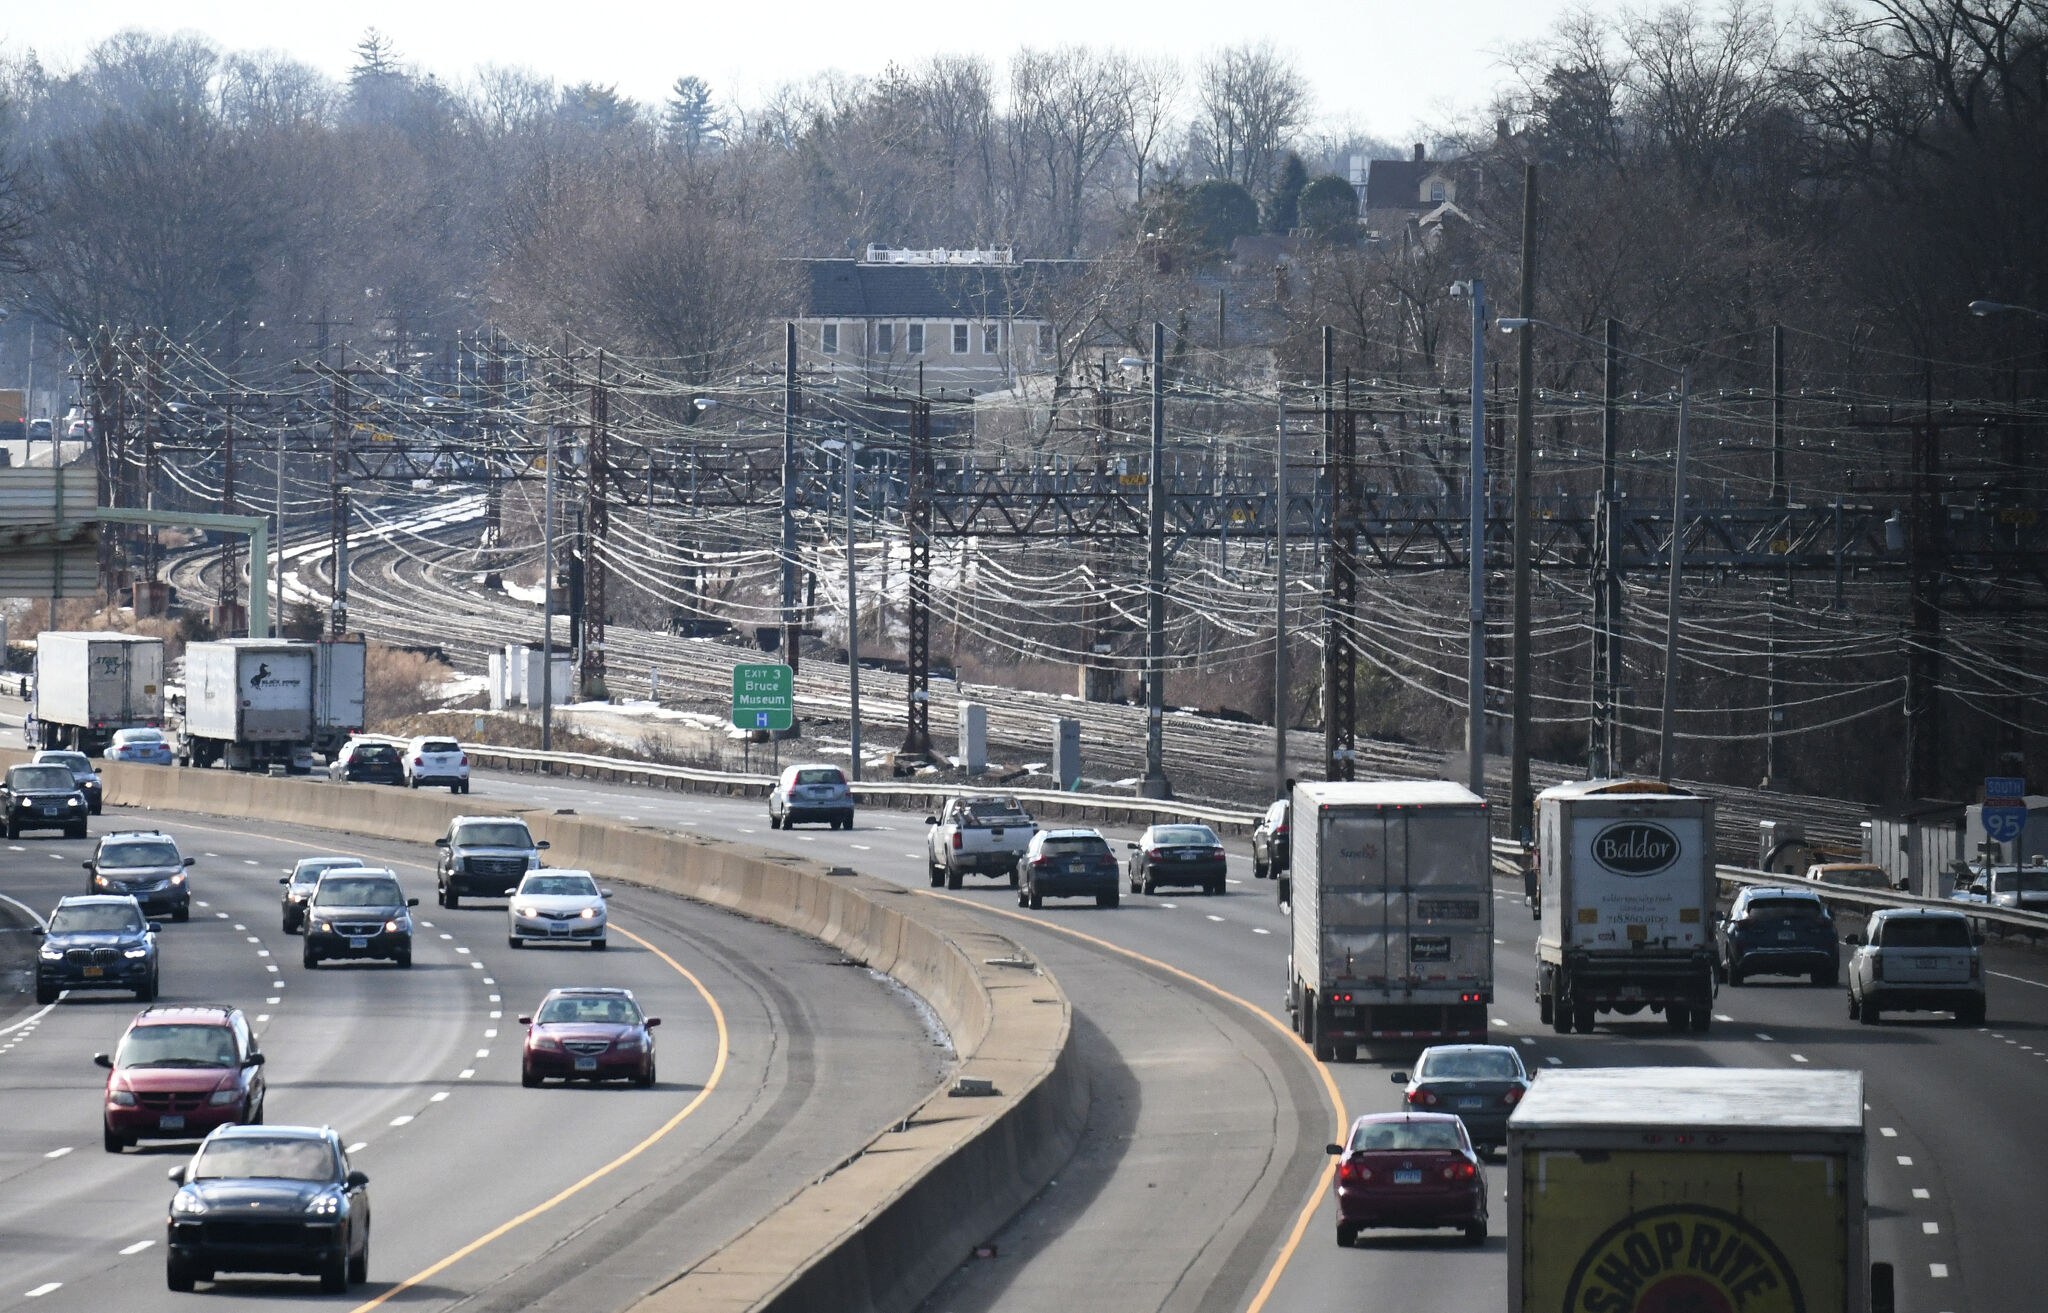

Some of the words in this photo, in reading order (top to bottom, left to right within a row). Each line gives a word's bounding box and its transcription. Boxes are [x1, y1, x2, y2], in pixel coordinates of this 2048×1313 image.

[744, 669, 768, 678] EXIT
[773, 669, 781, 679] 3
[745, 681, 779, 691] Bruce
[739, 694, 785, 704] Museum
[756, 713, 768, 727] H
[1988, 781, 2021, 793] SOUTH
[1988, 814, 2020, 836] 95
[1603, 829, 1670, 858] Baldor
[1583, 1222, 1684, 1313] SHOP
[1687, 1222, 1779, 1309] RITE
